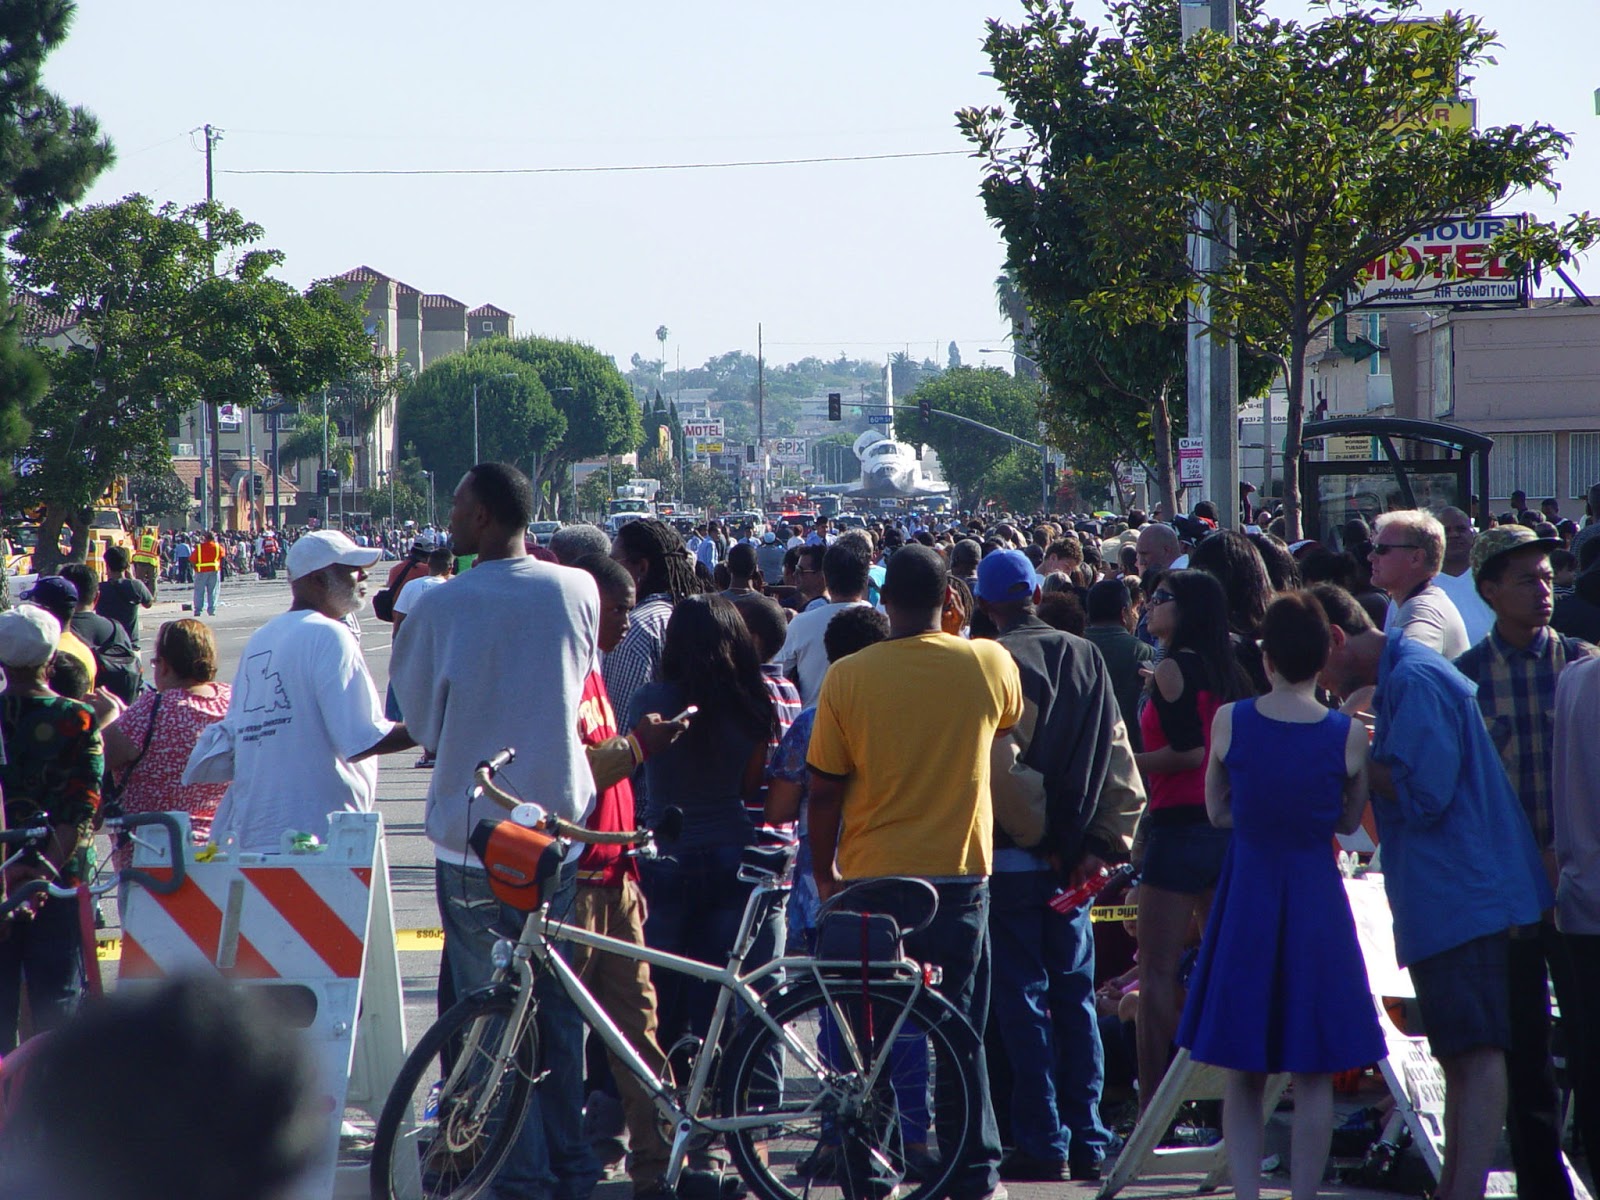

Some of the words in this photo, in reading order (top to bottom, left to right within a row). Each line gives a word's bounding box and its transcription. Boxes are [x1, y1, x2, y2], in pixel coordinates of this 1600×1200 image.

[1413, 221, 1506, 241] HOUR
[1434, 285, 1451, 298] AIR
[1457, 283, 1516, 297] CONDITION
[685, 425, 722, 437] MOTEL
